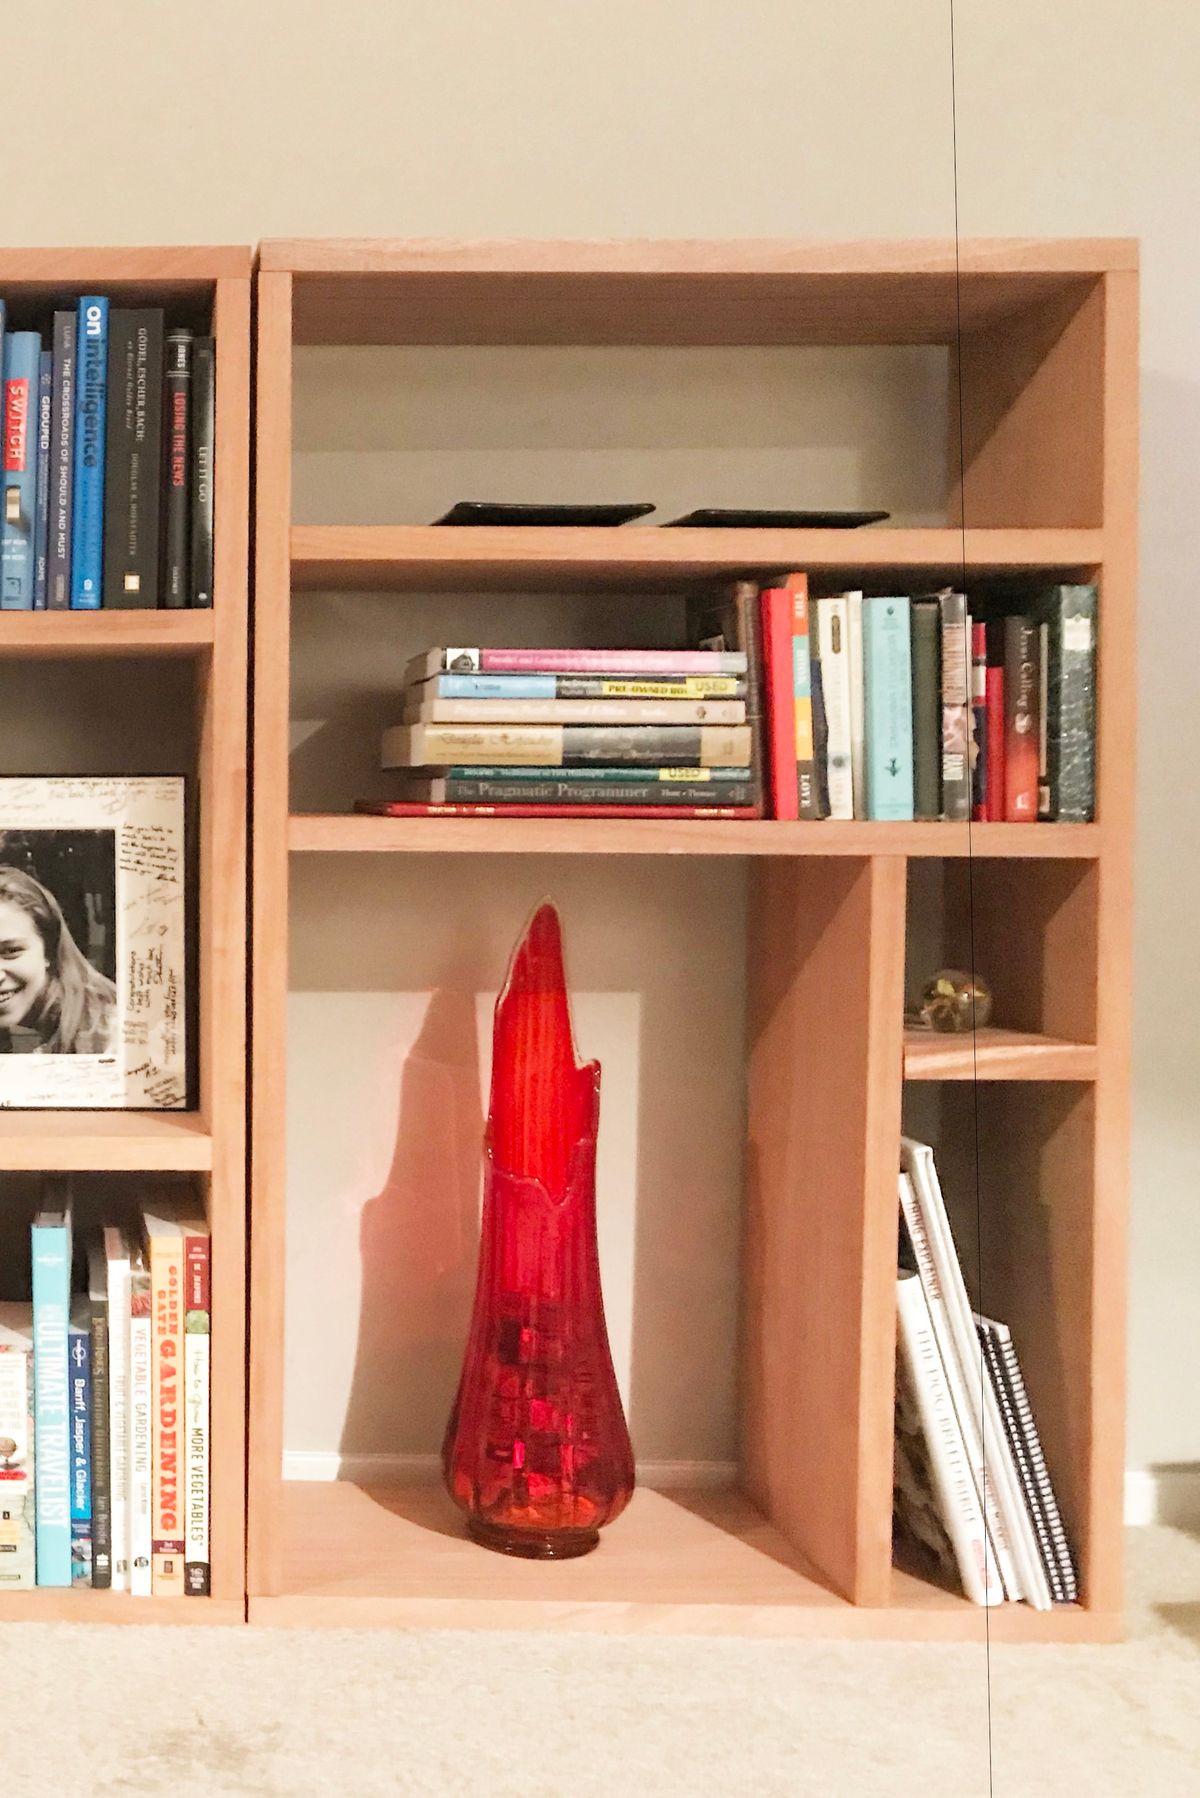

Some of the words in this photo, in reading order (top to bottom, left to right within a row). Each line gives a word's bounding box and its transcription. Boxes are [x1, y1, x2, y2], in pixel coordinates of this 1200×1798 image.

[63, 326, 71, 348] LUNA
[87, 306, 102, 335] on
[63, 359, 71, 376] THE
[177, 345, 185, 368] JONES
[60, 380, 71, 445] CROSSROADS
[81, 338, 105, 468] intelligence
[174, 392, 186, 430] LOSING
[9, 386, 23, 459] SWITCH
[40, 396, 50, 449] GROUPED
[60, 449, 70, 462] OF
[173, 435, 185, 453] THE
[198, 446, 208, 465] LET
[59, 465, 68, 505] SHOULD
[172, 457, 184, 487] NEWS
[199, 468, 208, 479] IT
[199, 483, 208, 502] GO
[58, 509, 67, 529] AND
[57, 533, 66, 558] MUST
[1018, 626, 1033, 659] Jesus
[696, 681, 728, 692] USED
[1016, 662, 1033, 708] Calling
[457, 786, 474, 796] The
[478, 784, 553, 801] Pragmatic
[558, 785, 649, 800] Programmer
[800, 774, 811, 808] LOVE
[905, 1199, 924, 1236] THING
[917, 1238, 942, 1302] EXPLAINER
[157, 1291, 166, 1335] GATE
[167, 1266, 178, 1335] GOLDEN
[37, 1322, 66, 1417] ULTIMATE
[74, 1379, 86, 1412] Banff,
[73, 1416, 87, 1454] Jasper
[160, 1340, 177, 1532] GARDENING
[191, 1427, 203, 1461] MORE
[40, 1422, 67, 1528] TRAVELIST
[75, 1456, 86, 1466] &
[75, 1470, 88, 1510] Glacier
[191, 1466, 204, 1542] VEGETABLES
